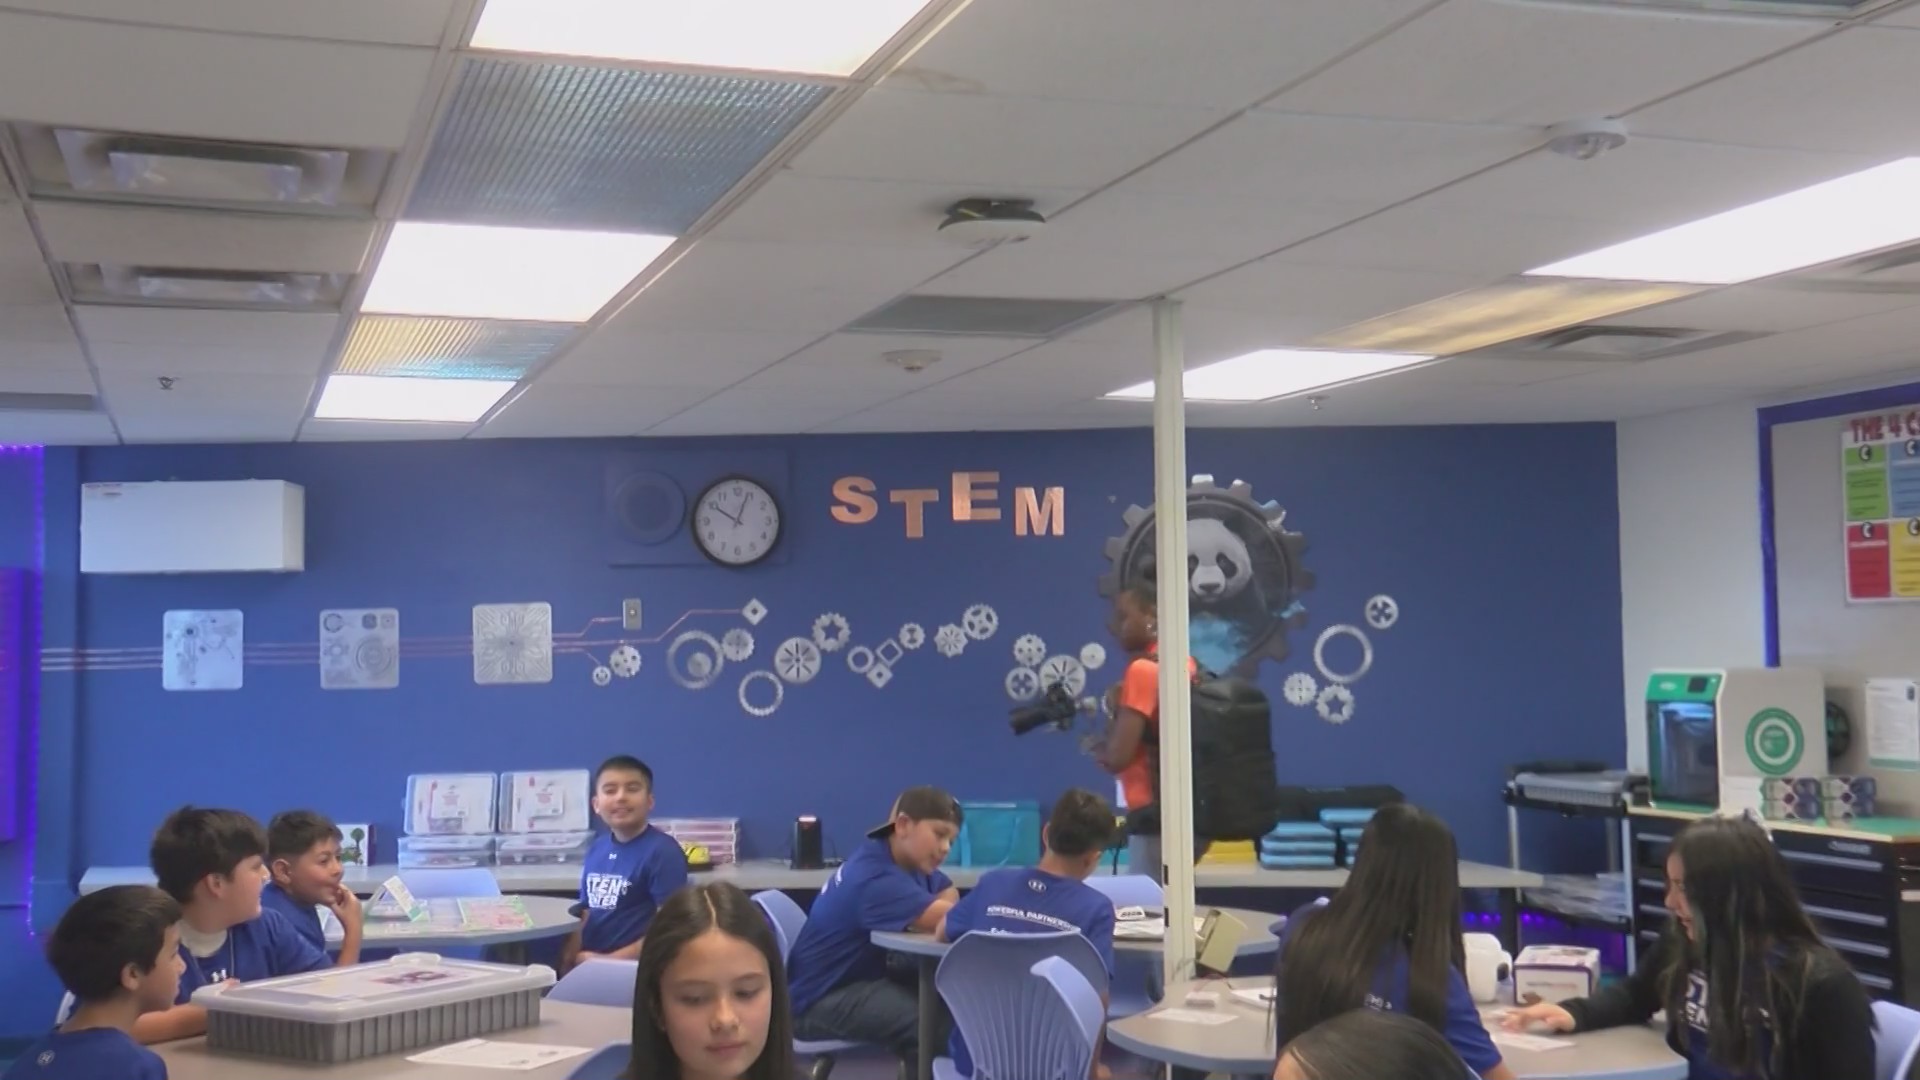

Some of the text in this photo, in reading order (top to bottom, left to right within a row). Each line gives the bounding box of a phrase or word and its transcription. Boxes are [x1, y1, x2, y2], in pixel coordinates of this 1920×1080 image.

[1850, 415, 1883, 443] THE
[1889, 414, 1902, 437] 4
[830, 471, 1065, 538] STEM
